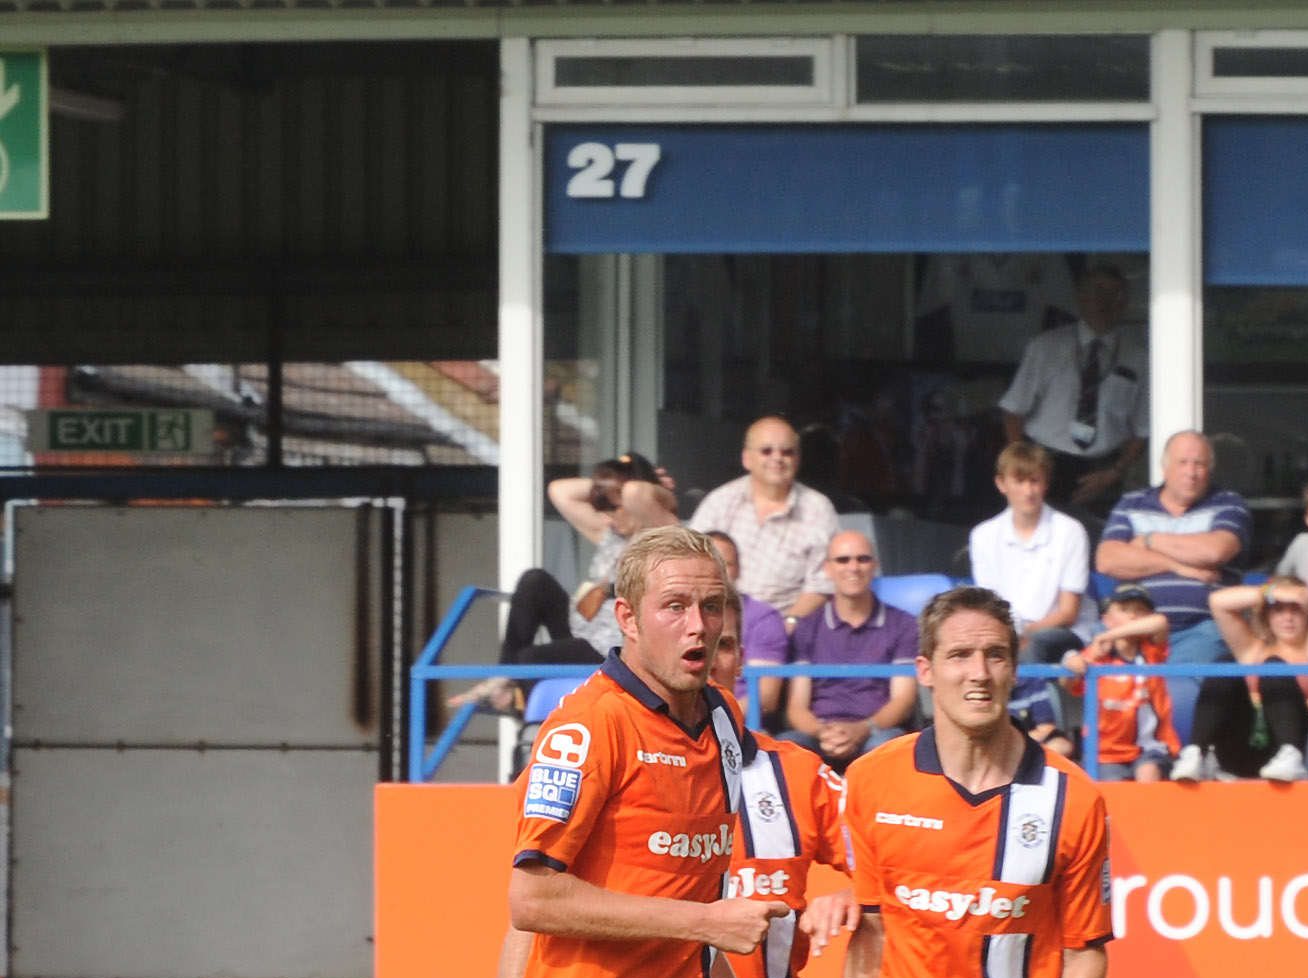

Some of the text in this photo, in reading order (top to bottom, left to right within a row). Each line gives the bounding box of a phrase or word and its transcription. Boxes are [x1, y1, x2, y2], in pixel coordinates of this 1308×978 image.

[566, 142, 661, 198] 27
[57, 417, 133, 445] EXIT
[528, 783, 559, 801] SQ
[530, 768, 579, 789] BLUE
[526, 803, 570, 819] PREMIER
[648, 824, 734, 863] easyJ
[894, 884, 1031, 921] easyJet
